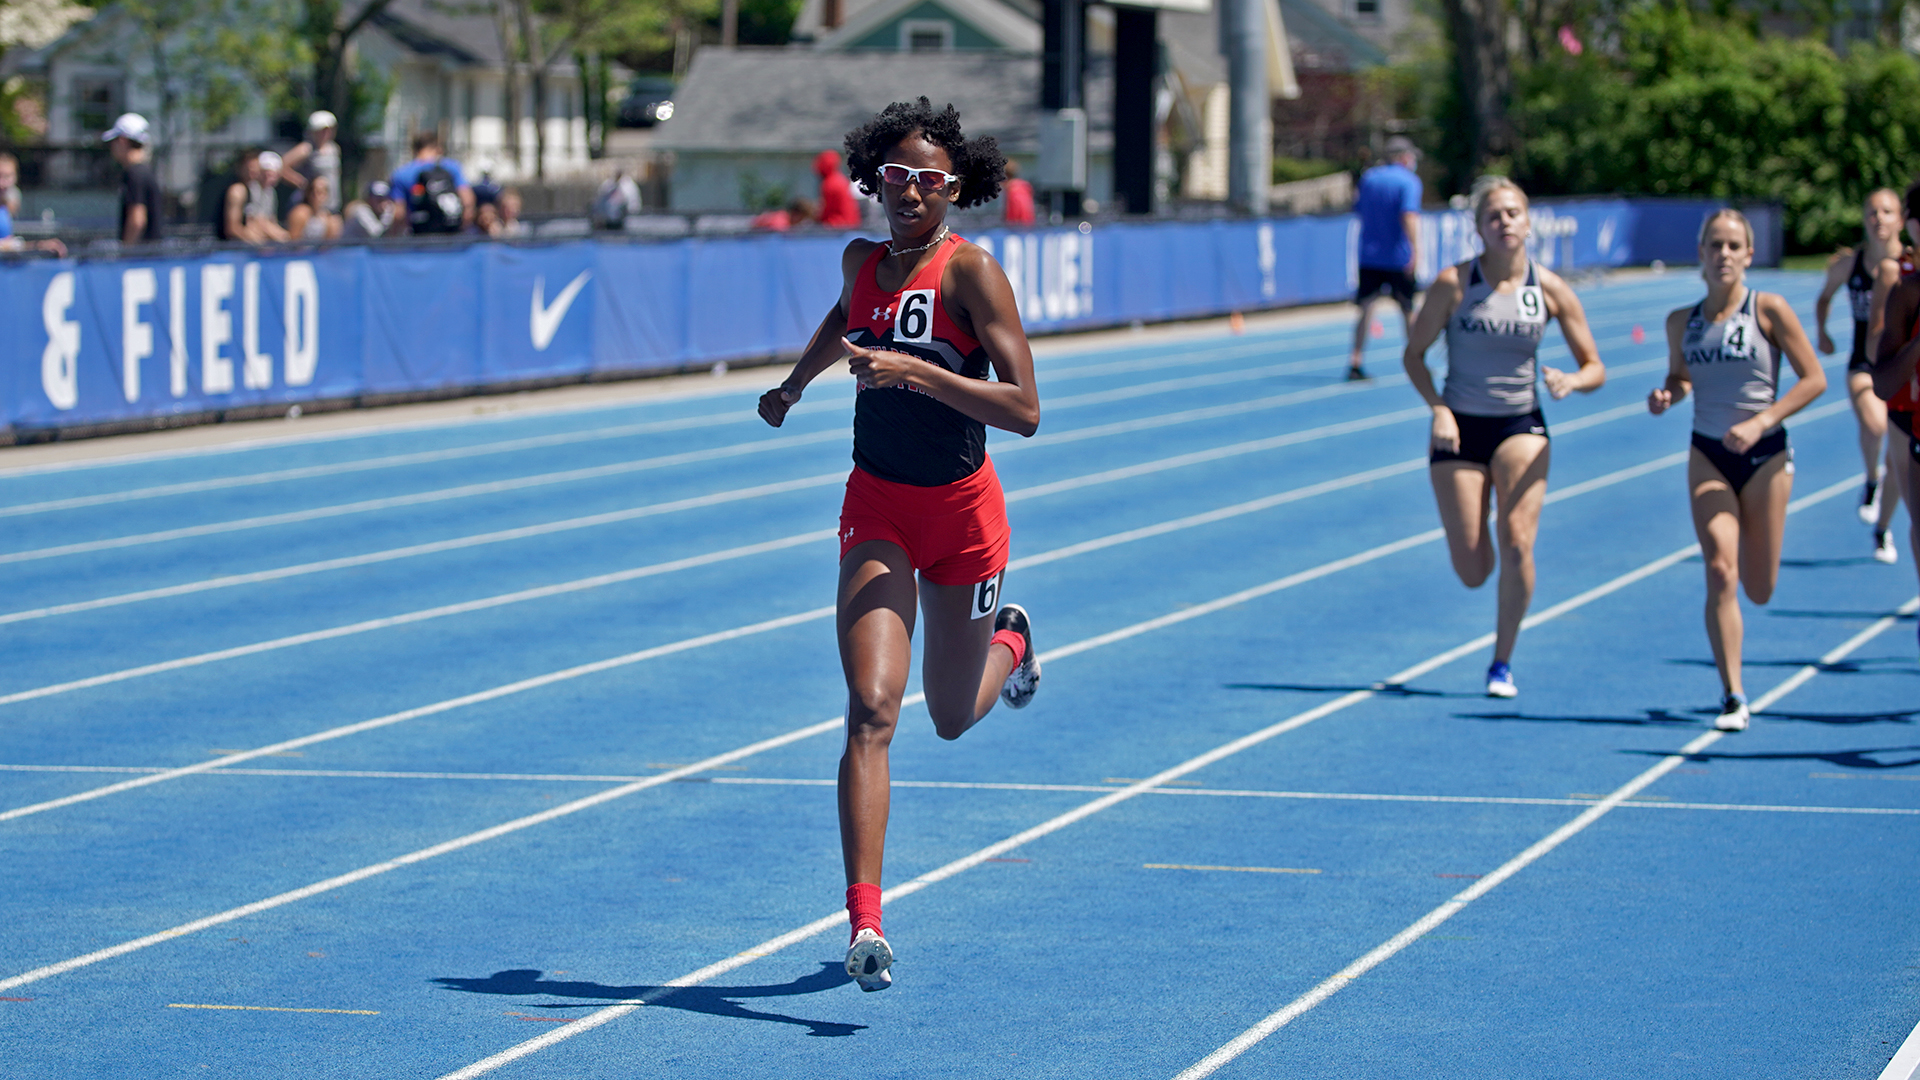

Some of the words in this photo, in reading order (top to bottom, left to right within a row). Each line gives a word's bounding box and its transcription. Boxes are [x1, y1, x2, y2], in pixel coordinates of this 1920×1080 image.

[900, 293, 928, 339] 6
[1522, 290, 1539, 317] 9
[42, 271, 81, 410] &
[122, 260, 319, 404] FIELD
[1728, 325, 1745, 351] 4
[978, 573, 998, 614] 6
